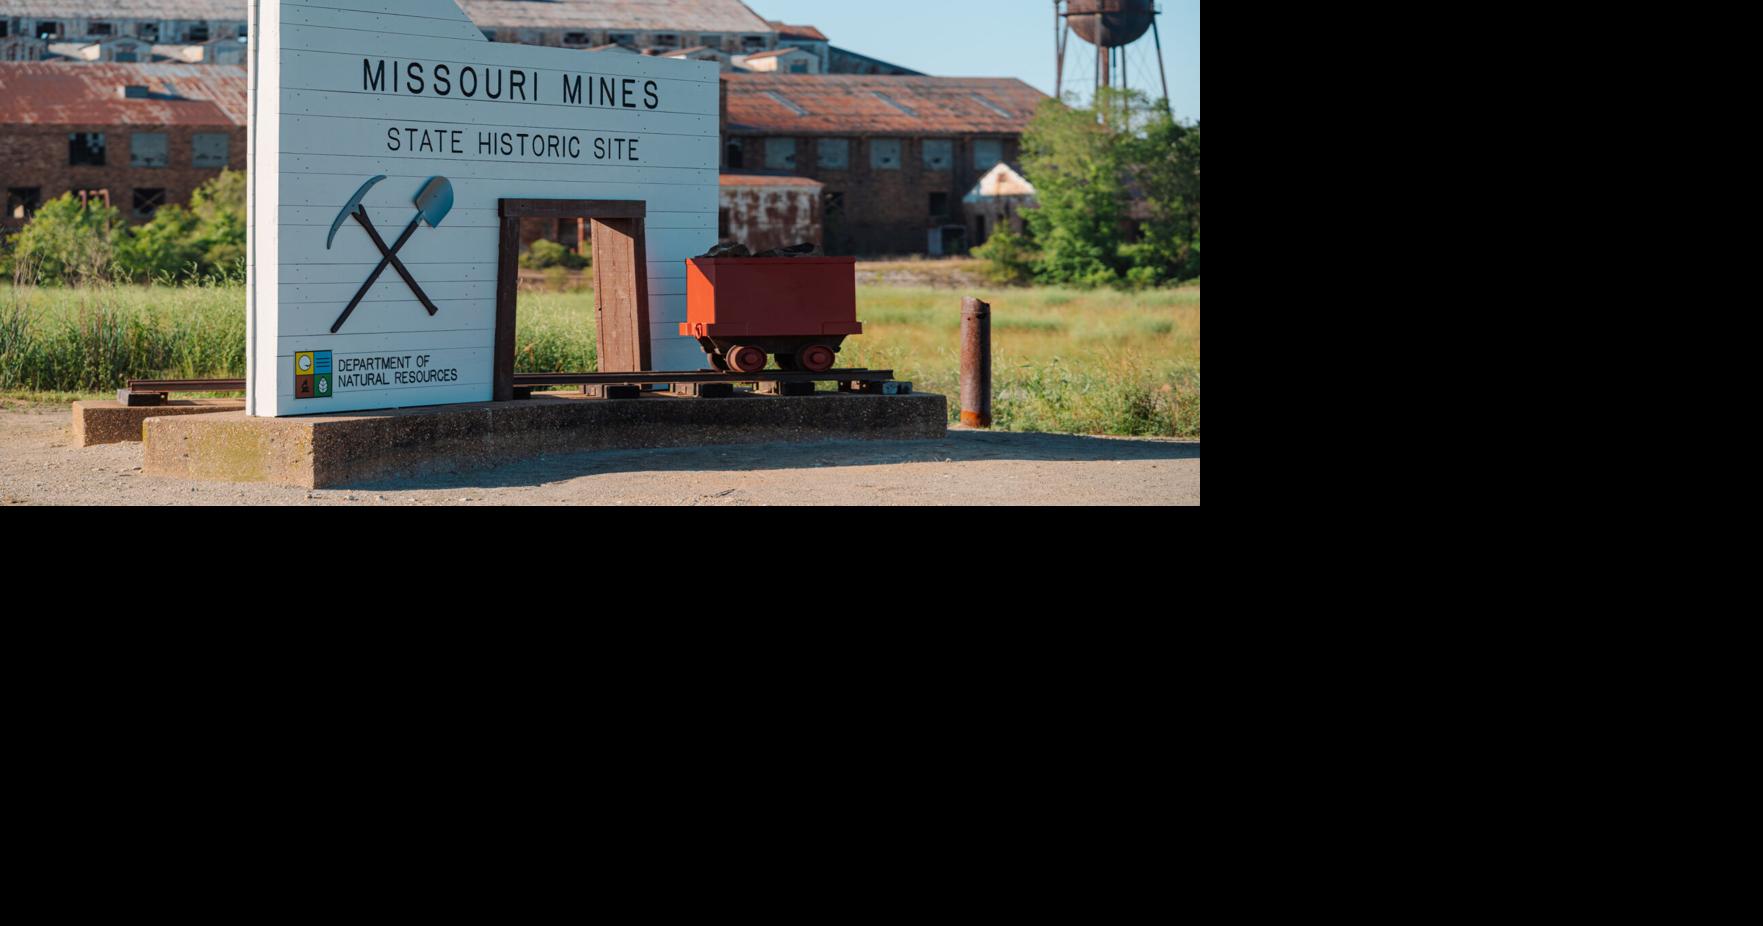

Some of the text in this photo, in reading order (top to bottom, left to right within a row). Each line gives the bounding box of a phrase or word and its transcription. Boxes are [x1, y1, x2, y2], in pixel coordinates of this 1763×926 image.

[363, 58, 659, 110] MISSOURI MINES
[386, 126, 640, 161] STATE HISTORIC SITE
[338, 354, 431, 372] DEPARTMENT OF
[338, 368, 458, 388] NATURAL RESOURCES
